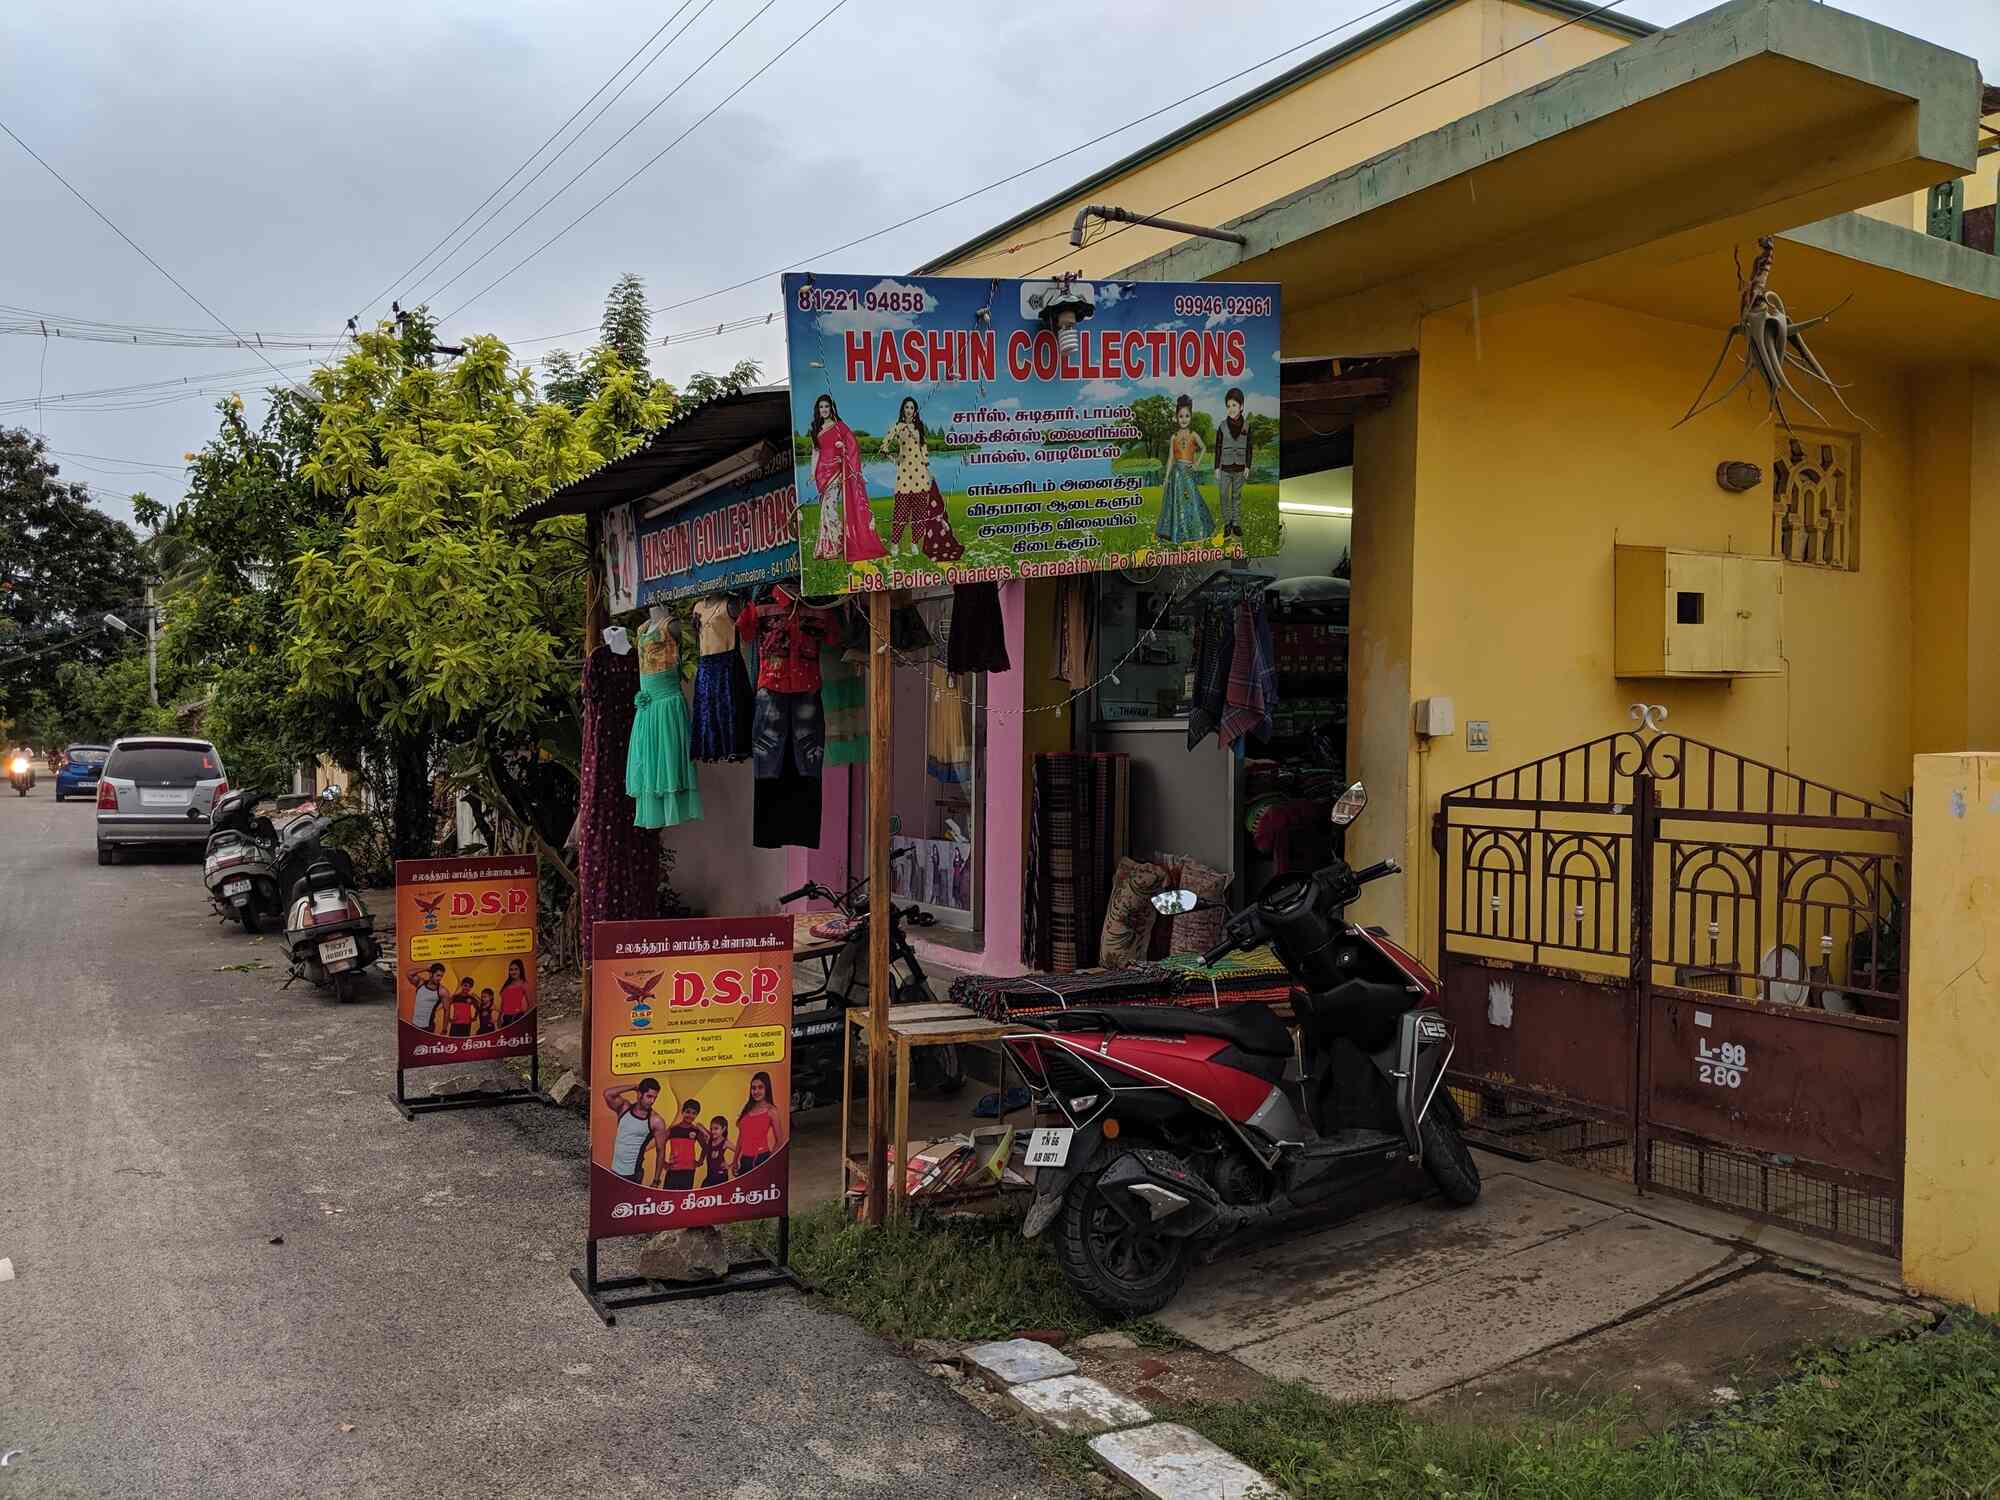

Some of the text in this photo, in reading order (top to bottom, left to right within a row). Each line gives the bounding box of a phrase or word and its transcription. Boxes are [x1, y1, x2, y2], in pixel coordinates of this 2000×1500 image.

[799, 290, 924, 313] 81221 94858
[1174, 296, 1273, 317] 99946 92961
[845, 330, 1247, 383] HASHIN COLLECTIONS
[967, 476, 1142, 497] எங்களிடம் அனைத்து
[967, 493, 1143, 518] விதமான ஆடைகளும்
[641, 483, 800, 581] HASHIN COLLECTIONS
[978, 513, 1137, 538] குறைந்த விலையில்
[730, 567, 766, 586] Coimbatore
[892, 571, 941, 588] Police
[1020, 558, 1098, 579] Ganapathy
[1145, 547, 1222, 566] Coimbatore
[615, 938, 669, 955] உலகத்தரம்
[461, 1032, 534, 1051] கிடைக்கும்
[1418, 1021, 1447, 1039] 125
[1700, 1037, 1746, 1067] L-98
[1699, 1064, 1742, 1088] 280
[611, 1184, 782, 1219] இங்கு கிடைக்கும்
